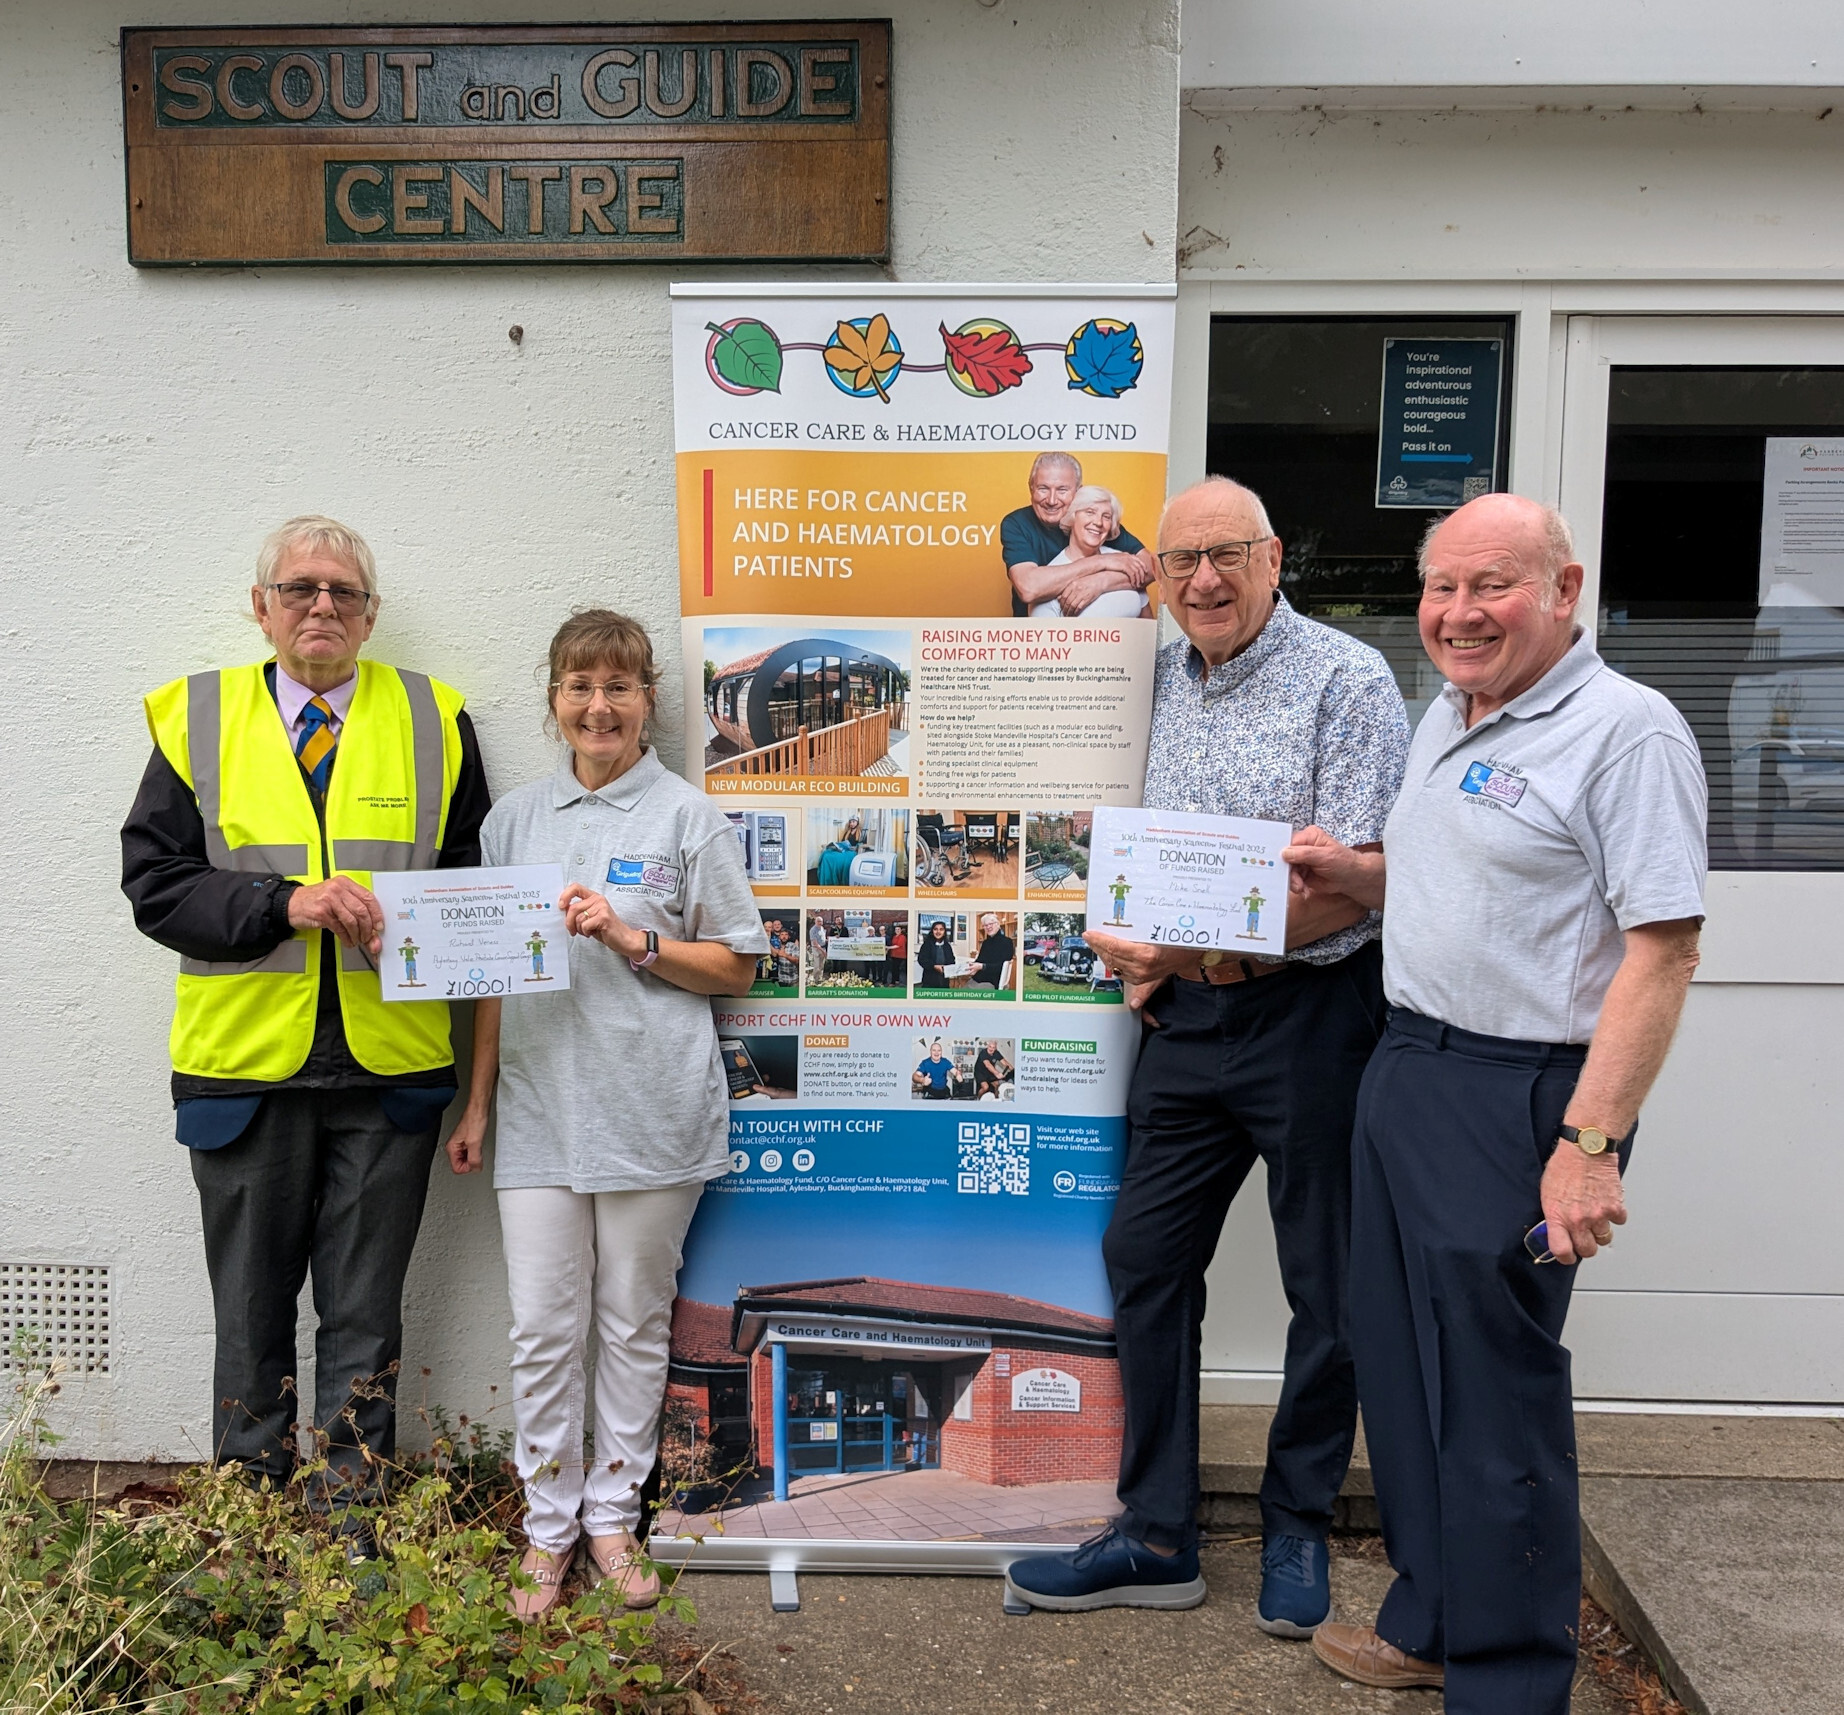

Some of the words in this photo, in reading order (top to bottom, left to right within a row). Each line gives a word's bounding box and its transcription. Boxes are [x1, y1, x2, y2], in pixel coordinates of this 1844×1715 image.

[161, 51, 434, 122] SCOUT
[460, 74, 561, 121] and
[580, 47, 852, 121] GUIDE
[334, 164, 681, 235] CENTRE
[1407, 352, 1440, 362] You're
[1406, 365, 1472, 377] inspirational
[1405, 380, 1472, 390] adventurous
[1404, 395, 1469, 405] enthusiastic
[1403, 411, 1466, 421] courageous
[708, 422, 800, 440] CANCER
[806, 423, 865, 440] CARE
[873, 425, 890, 441] &
[897, 423, 1067, 441] HAEMATOLOGY
[1074, 424, 1137, 441] FUND
[1402, 442, 1426, 451] Pass
[1429, 442, 1436, 451] it
[734, 488, 799, 509] HERE
[806, 490, 857, 511] FOR
[865, 491, 968, 512] CANCER
[732, 522, 790, 543] AND
[799, 523, 997, 546] HAEMATOLOGY
[733, 555, 853, 578] PATIENTS
[922, 630, 982, 643] RAISING
[987, 630, 1043, 643] MONEY
[1047, 630, 1068, 643] TO
[1073, 630, 1121, 643] BRING
[921, 648, 996, 660] COMFORT
[1000, 648, 1021, 660] TO
[1026, 648, 1072, 660] MANY
[953, 666, 975, 674] charity
[1018, 666, 1053, 674] supporting
[1055, 666, 1077, 674] people
[993, 674, 1036, 682] haematology
[1066, 675, 1075, 683] by
[1076, 675, 1131, 683] Buckinghamshire
[711, 780, 738, 791] NEW
[741, 780, 806, 792] MODULAR
[810, 782, 835, 792] ECO
[838, 782, 900, 793] BUILDING
[1160, 849, 1226, 867] DONATION
[1171, 864, 1196, 872] FUNDS
[1198, 867, 1224, 875] RAISED
[522, 890, 541, 899] 2025
[616, 886, 665, 898] ASSOCIATION
[441, 906, 504, 920] DONATION
[446, 975, 511, 996] £1000!
[712, 1014, 765, 1027] UPPORT
[769, 1014, 807, 1027] CCHF
[811, 1014, 826, 1027] IN
[831, 1014, 872, 1027] YOUR
[877, 1014, 914, 1027] OWN
[918, 1015, 952, 1027] WAY
[806, 1038, 847, 1046] DONATE
[1024, 1041, 1094, 1051] FUNDRAISING
[834, 1052, 851, 1060] ready
[729, 1122, 743, 1134] IN
[747, 1121, 799, 1133] TOUCH
[803, 1121, 841, 1133] WITH
[846, 1120, 884, 1132] CCHF
[1036, 1135, 1100, 1145] www.cchf.org.uk
[1070, 1144, 1113, 1152] information
[1057, 1177, 1072, 1187] FR
[716, 1185, 755, 1193] Mandeville
[756, 1185, 788, 1194] Hospital,
[789, 1185, 826, 1193] Aylesbury,
[828, 1185, 892, 1193] Buckinghamshire,
[778, 1325, 826, 1337] Cancer
[831, 1327, 860, 1339] Care
[866, 1332, 887, 1341] and
[893, 1332, 962, 1347] Haematology
[966, 1337, 986, 1347] Unit
[1032, 1387, 1070, 1395] Haematology
